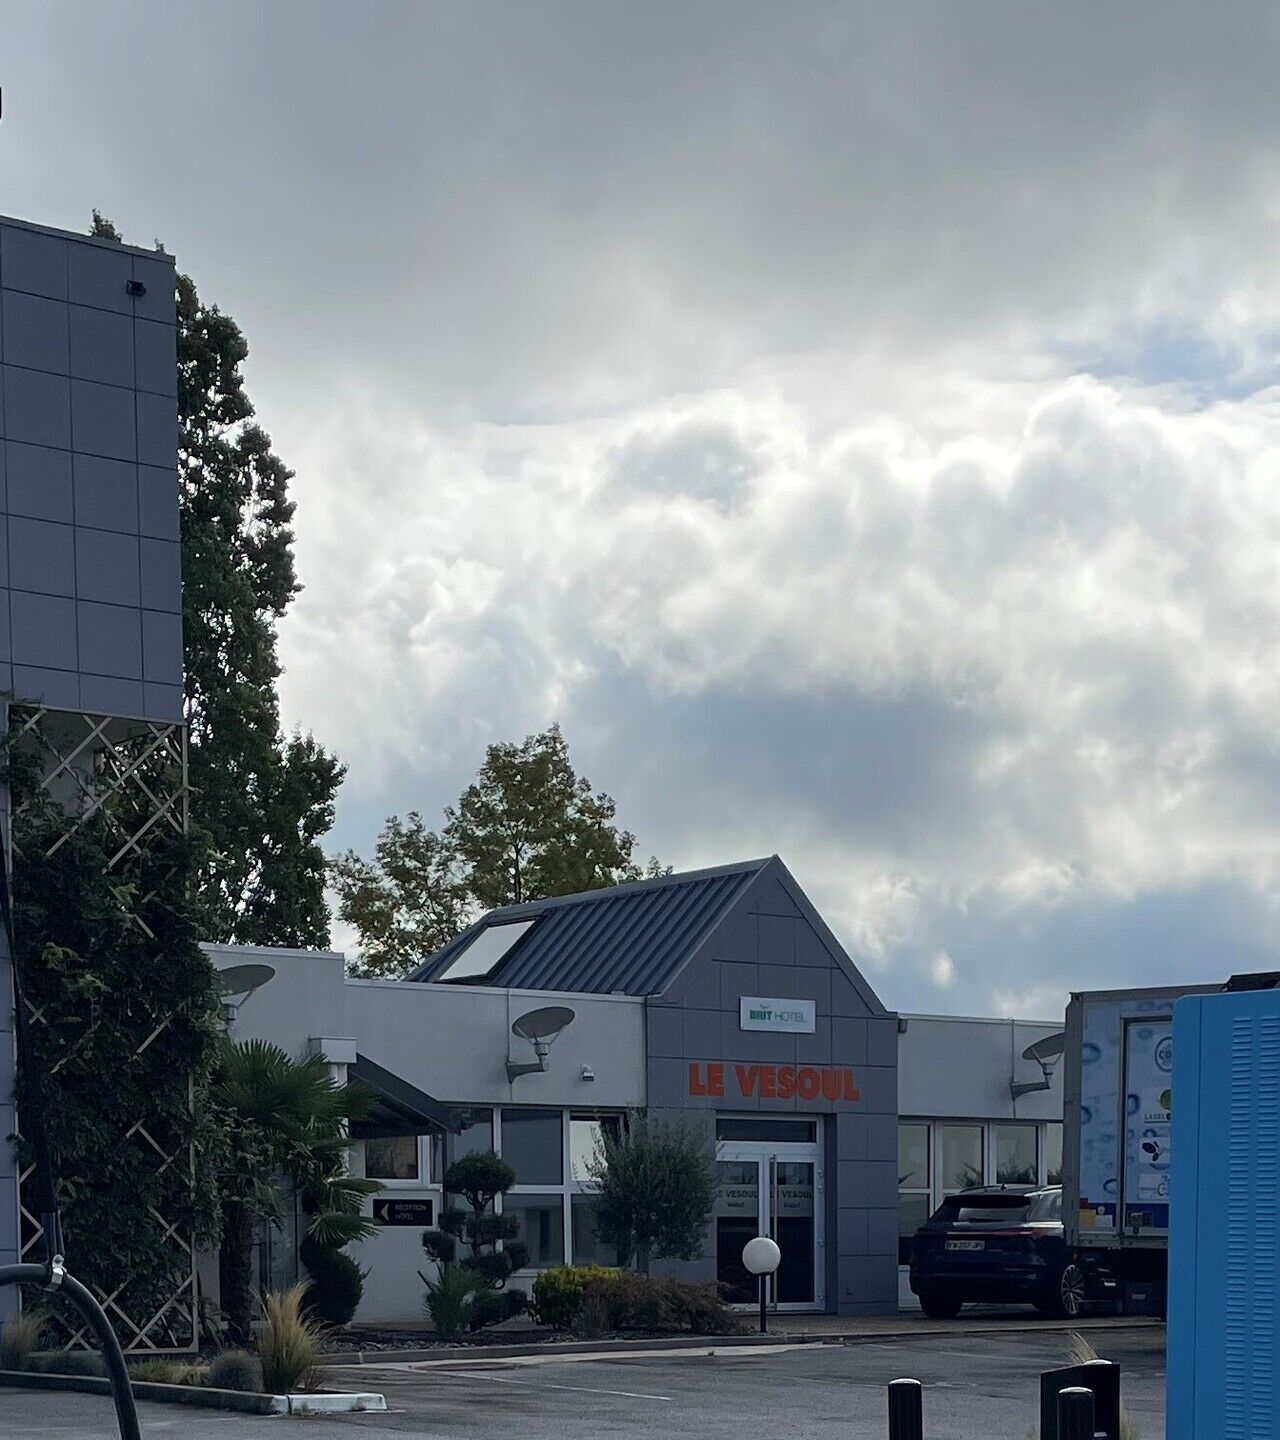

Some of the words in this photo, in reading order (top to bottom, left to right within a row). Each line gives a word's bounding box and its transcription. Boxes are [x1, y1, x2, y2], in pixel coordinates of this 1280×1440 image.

[749, 1010, 773, 1021] BRIT
[774, 1011, 807, 1022] HOTEL
[689, 1063, 725, 1096] LE
[735, 1065, 860, 1101] VESOUL
